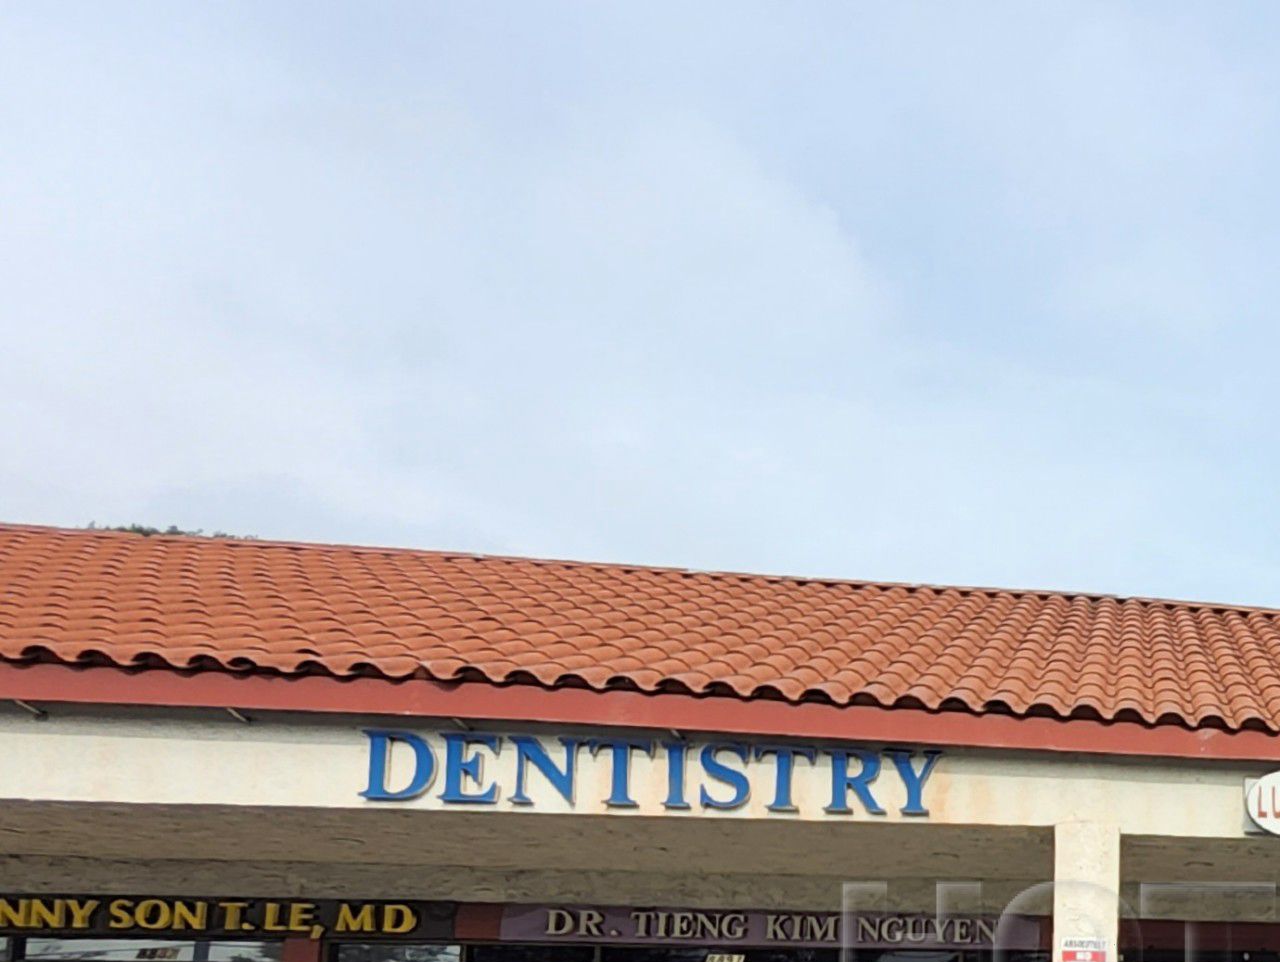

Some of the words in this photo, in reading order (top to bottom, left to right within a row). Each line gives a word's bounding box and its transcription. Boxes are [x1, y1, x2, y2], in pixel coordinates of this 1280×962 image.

[357, 728, 943, 817] DENTISTRY
[109, 899, 207, 930] SON
[545, 909, 618, 937] DR.
[631, 910, 748, 940] TIENG
[765, 914, 838, 942] KIM
[855, 915, 998, 944] NGUYEN
